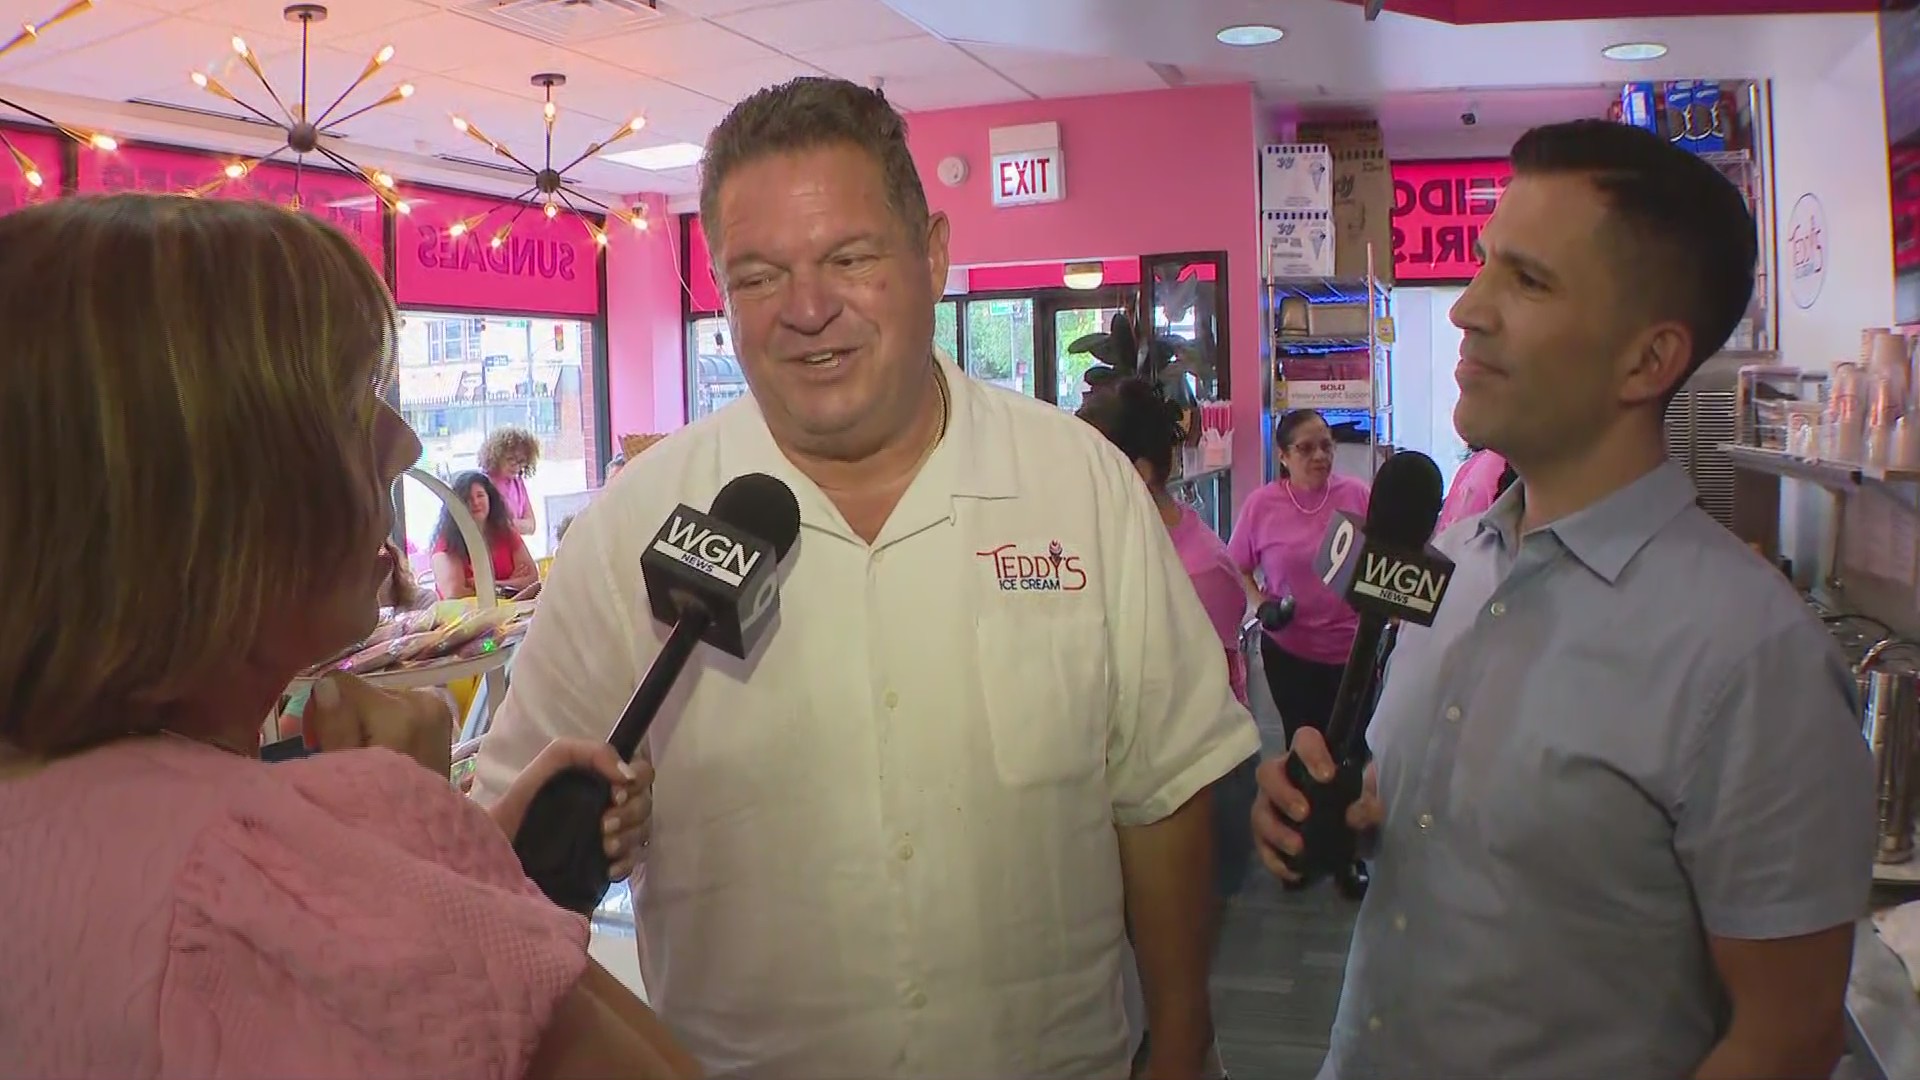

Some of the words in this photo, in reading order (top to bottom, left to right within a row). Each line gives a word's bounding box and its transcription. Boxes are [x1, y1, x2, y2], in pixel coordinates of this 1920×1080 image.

[1000, 158, 1050, 197] EXIT
[1345, 391, 1370, 400] Spoon
[667, 516, 761, 577] WGN
[681, 553, 715, 572] NEWS
[1322, 519, 1354, 586] 9
[976, 544, 1086, 590] TEDDY'S
[999, 579, 1018, 590] ICE
[1020, 579, 1060, 590] CREAM
[1365, 552, 1446, 602] WGN
[1379, 589, 1410, 605] NEWS
